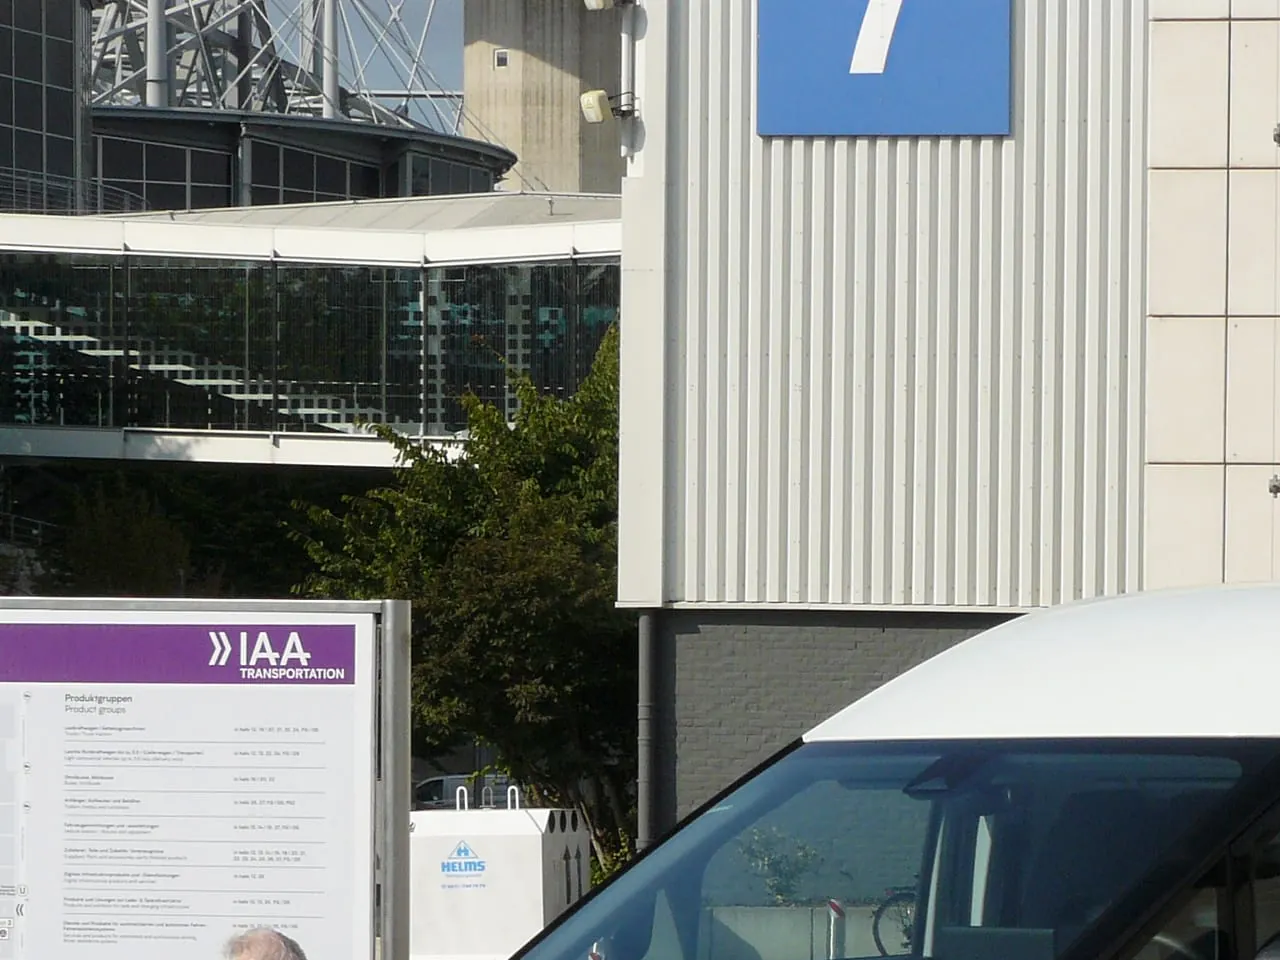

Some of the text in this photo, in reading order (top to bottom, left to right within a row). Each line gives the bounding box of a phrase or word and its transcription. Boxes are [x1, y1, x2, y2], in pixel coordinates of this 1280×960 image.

[239, 631, 312, 666] IAA
[239, 667, 345, 680] TRANSPORTATION
[64, 693, 133, 704] Produktgruppen
[64, 704, 126, 715] Product groups
[440, 860, 486, 873] HELMS
